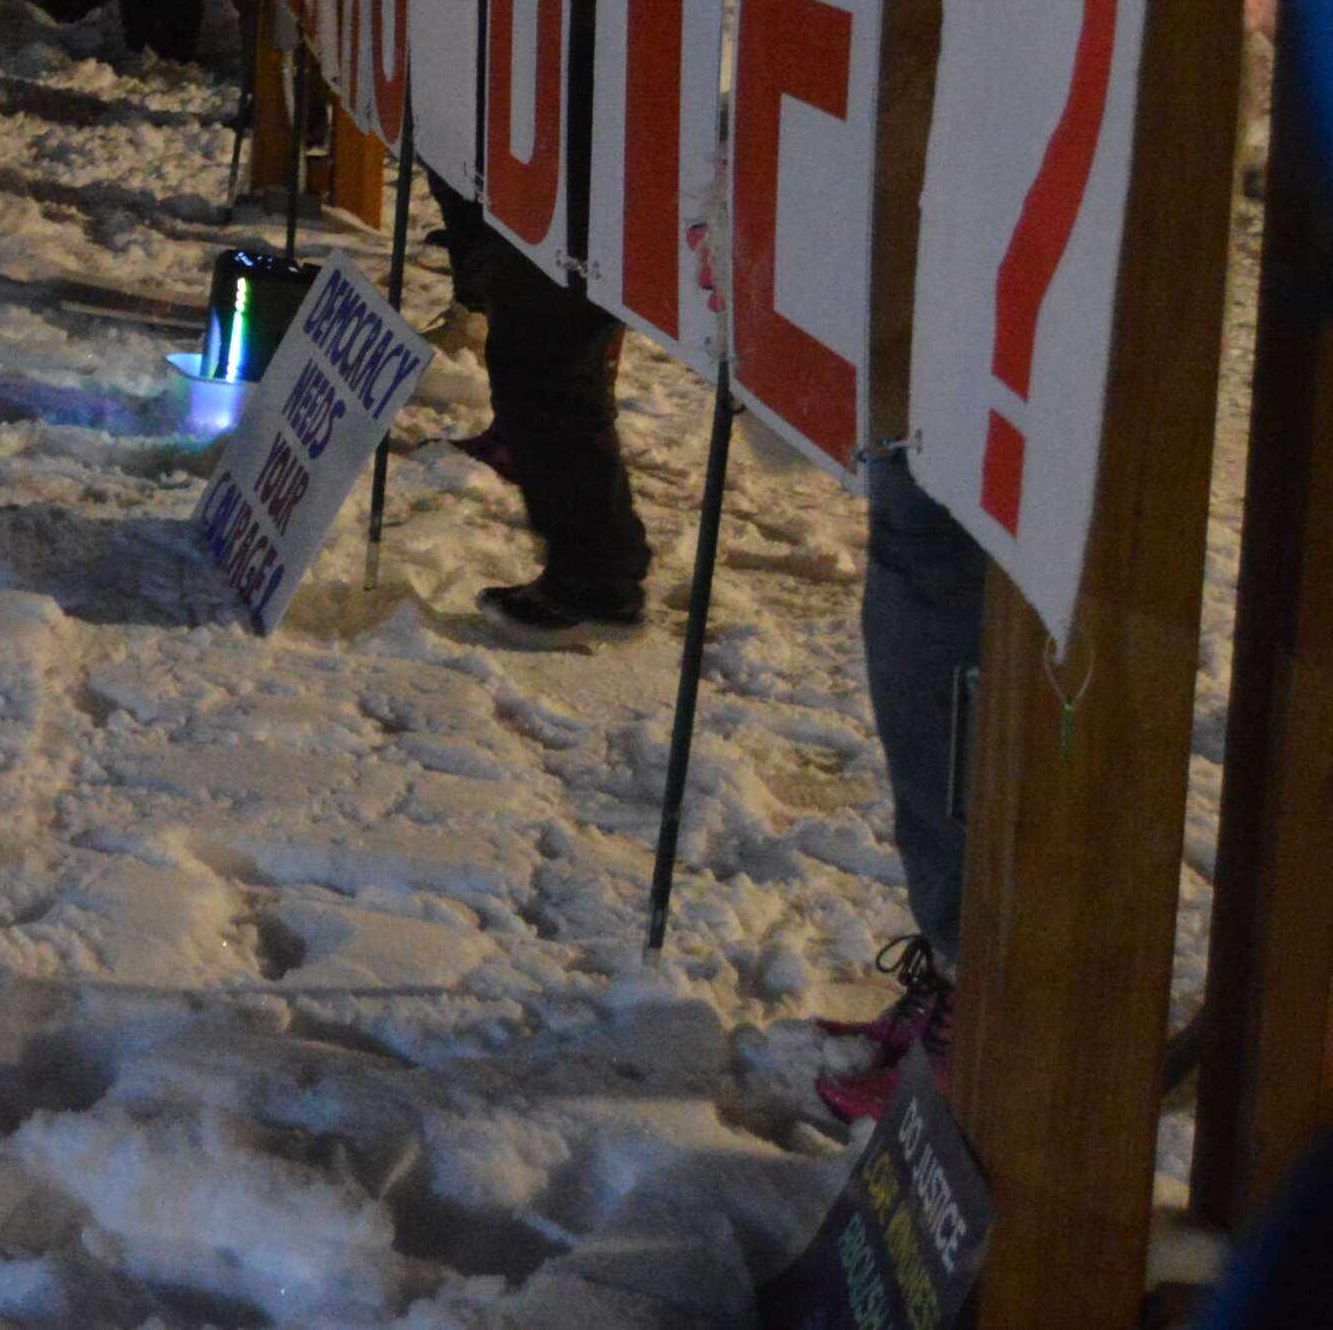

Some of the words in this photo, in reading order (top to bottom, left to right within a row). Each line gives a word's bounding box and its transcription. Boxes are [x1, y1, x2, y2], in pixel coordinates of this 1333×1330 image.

[302, 268, 420, 420] DEMOCRACY
[282, 358, 346, 460] NEEDS
[254, 430, 310, 537] YOUR
[898, 1096, 924, 1162] DO
[912, 1142, 967, 1274] JUSTICE
